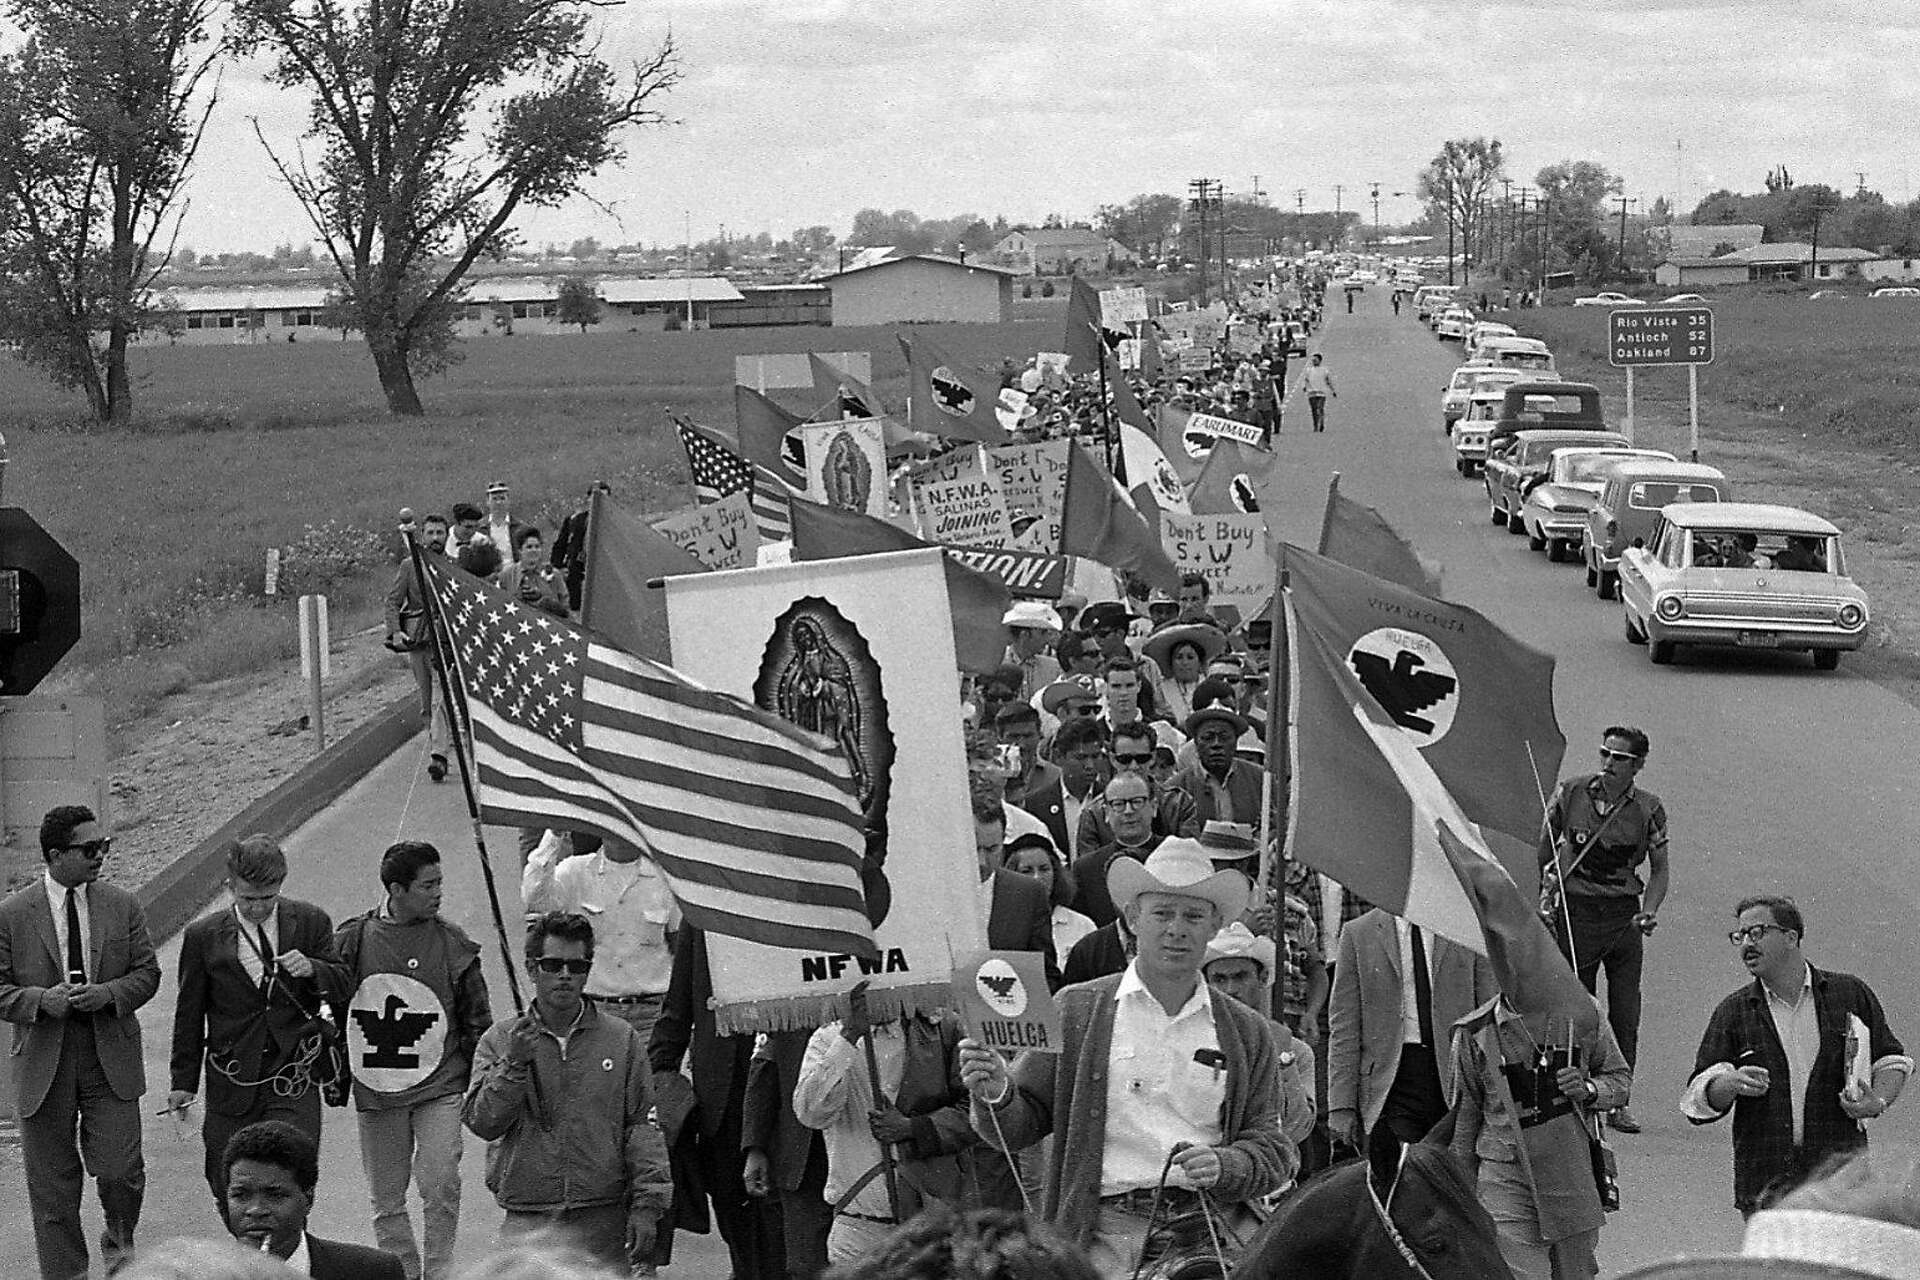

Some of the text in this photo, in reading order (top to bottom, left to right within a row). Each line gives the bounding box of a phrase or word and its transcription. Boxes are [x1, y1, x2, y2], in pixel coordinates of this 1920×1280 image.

[1617, 315, 1706, 327] Rio Vista 35
[1617, 331, 1706, 343] Antioch 52
[1617, 346, 1706, 358] Oakland 87
[928, 482, 998, 505] N.F.W.A.
[717, 507, 748, 529] Buy
[935, 498, 991, 516] SALINAS
[937, 509, 1002, 534] JOINING
[718, 527, 738, 550] W
[1217, 521, 1254, 550] Buy
[1177, 542, 1187, 560] S
[1208, 543, 1232, 563] W
[801, 948, 909, 982] NFWA
[981, 1020, 1049, 1048] HUELGA
